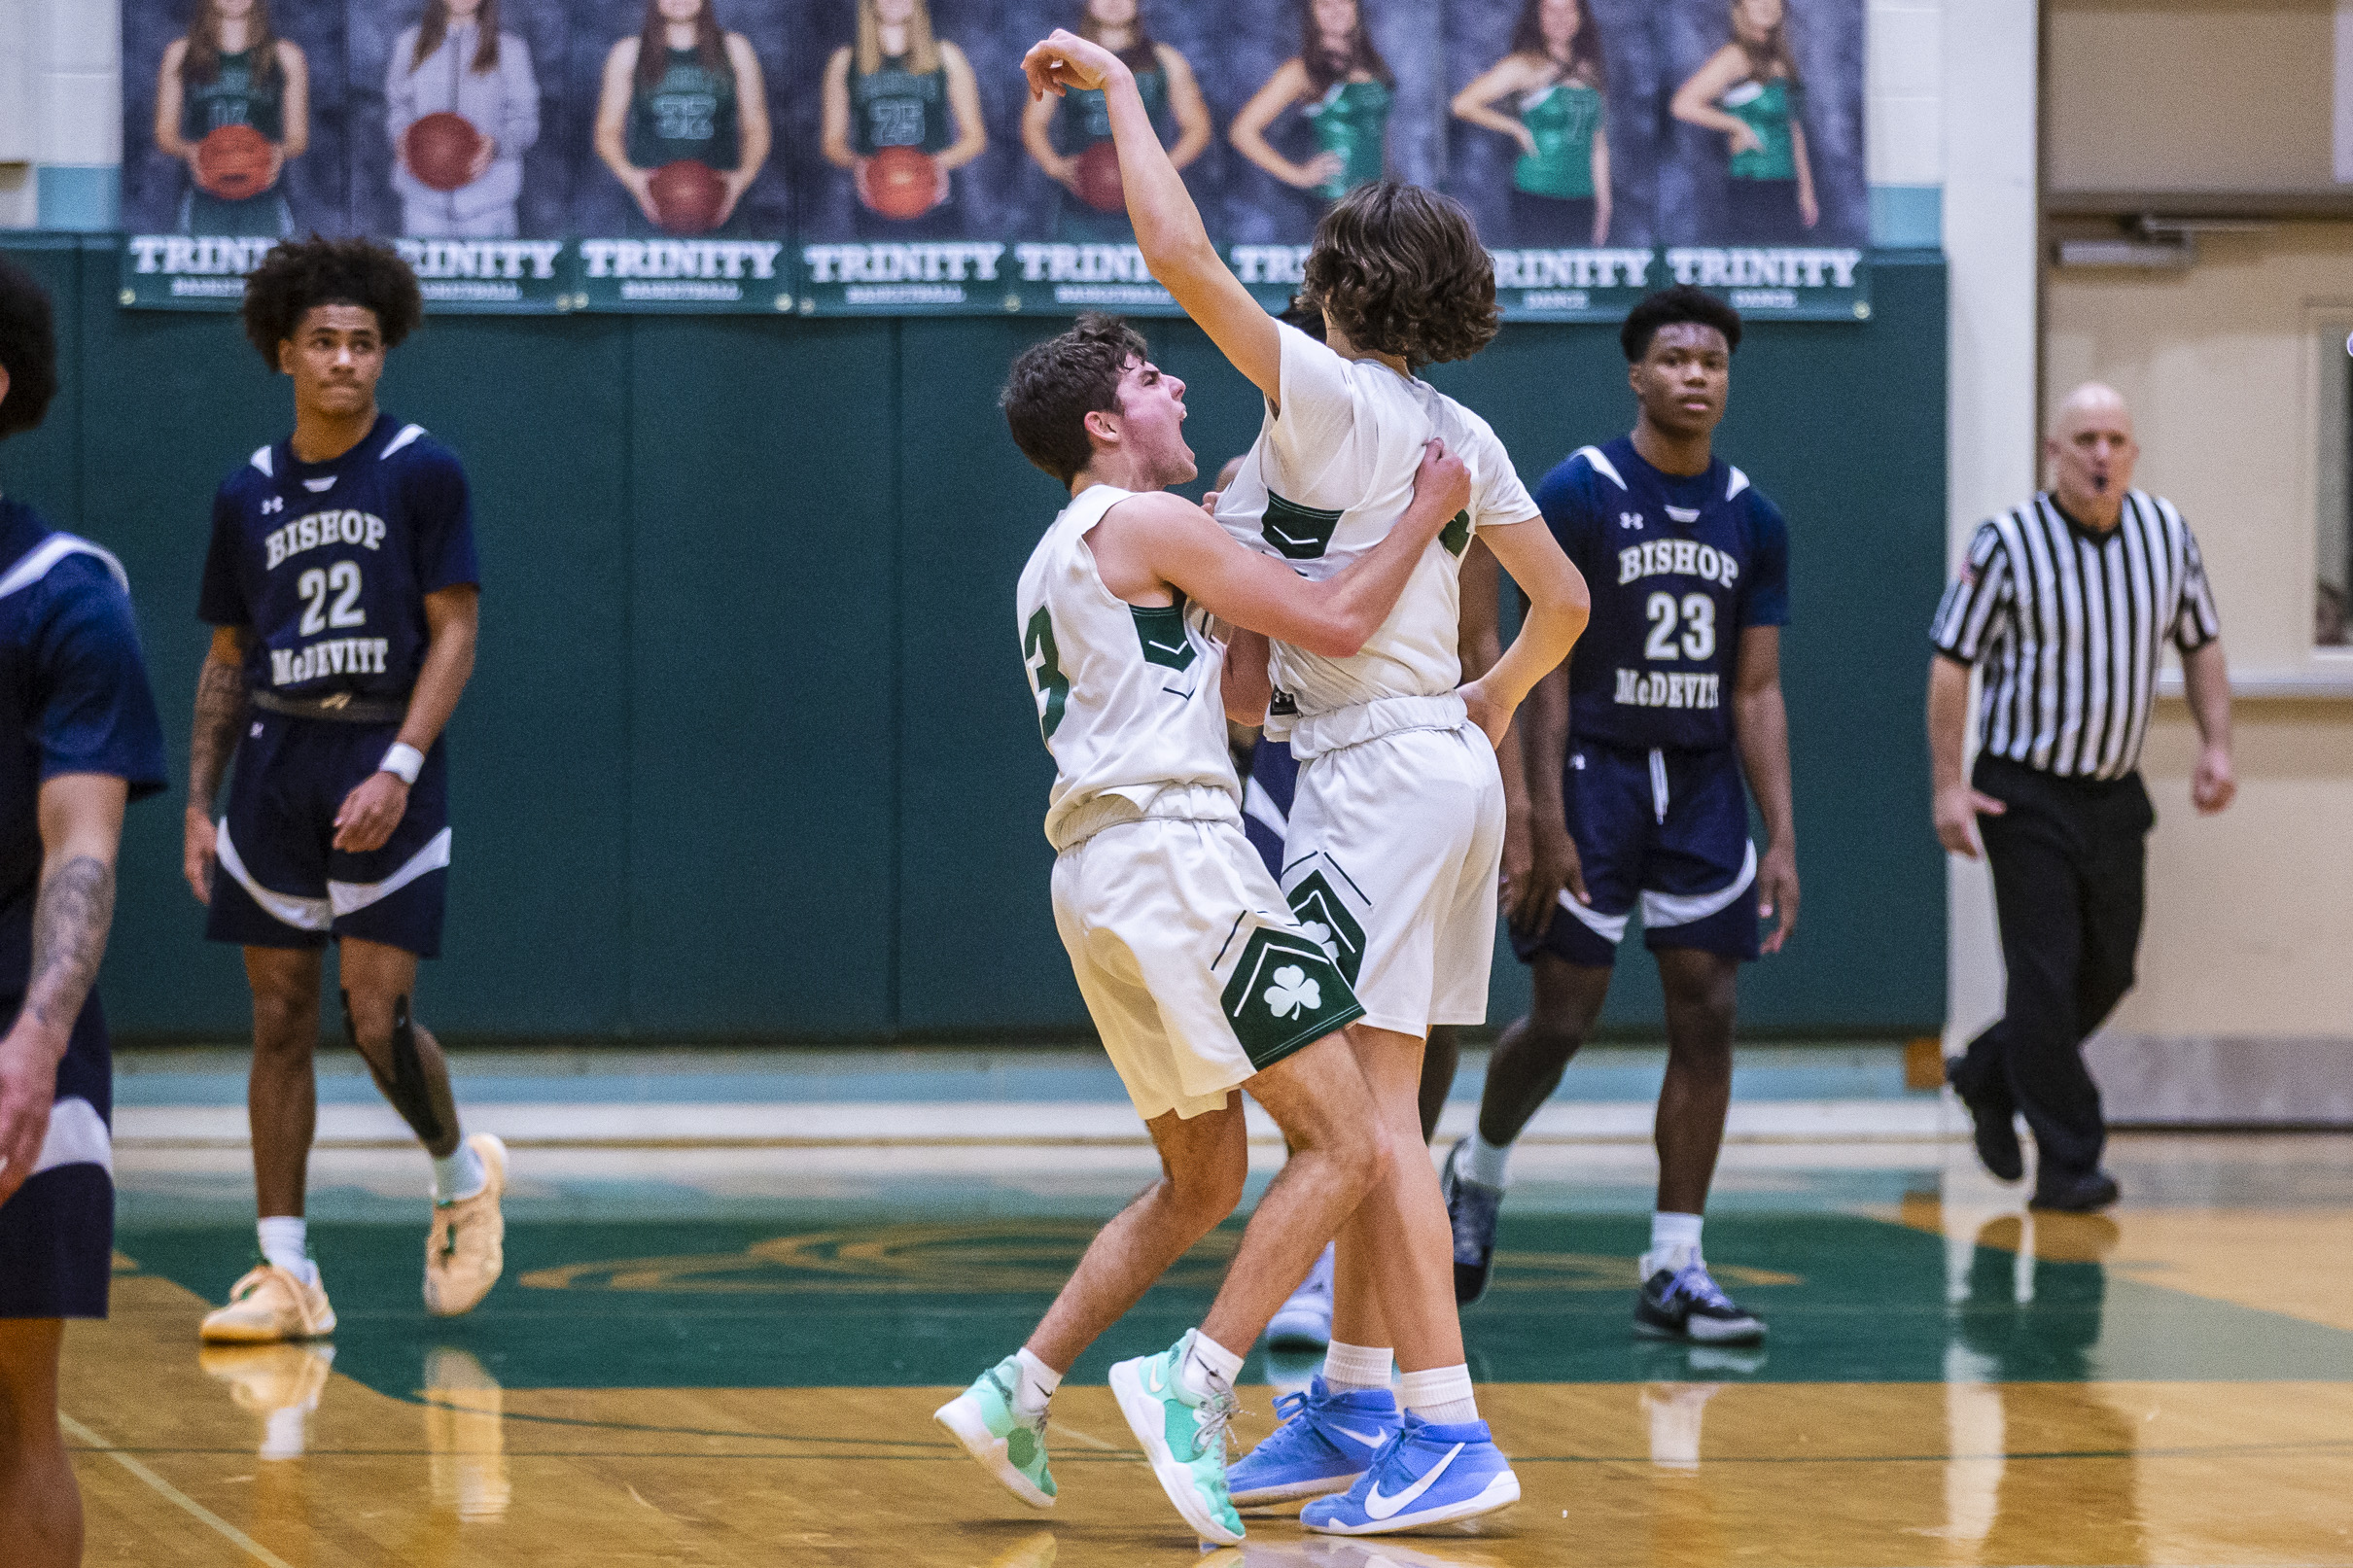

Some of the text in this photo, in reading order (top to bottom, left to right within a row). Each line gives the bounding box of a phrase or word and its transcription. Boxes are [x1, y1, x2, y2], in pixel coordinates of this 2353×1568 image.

[395, 238, 563, 279] RINITY
[579, 239, 784, 279] TRINITY
[803, 242, 1006, 283] TRINITY
[1493, 248, 1654, 289] RINITY
[1666, 247, 1862, 288] TRINITY
[264, 509, 387, 571] BISHOP
[1617, 539, 1739, 589] BISHOP
[298, 560, 367, 637] 22
[1643, 591, 1716, 661] 23
